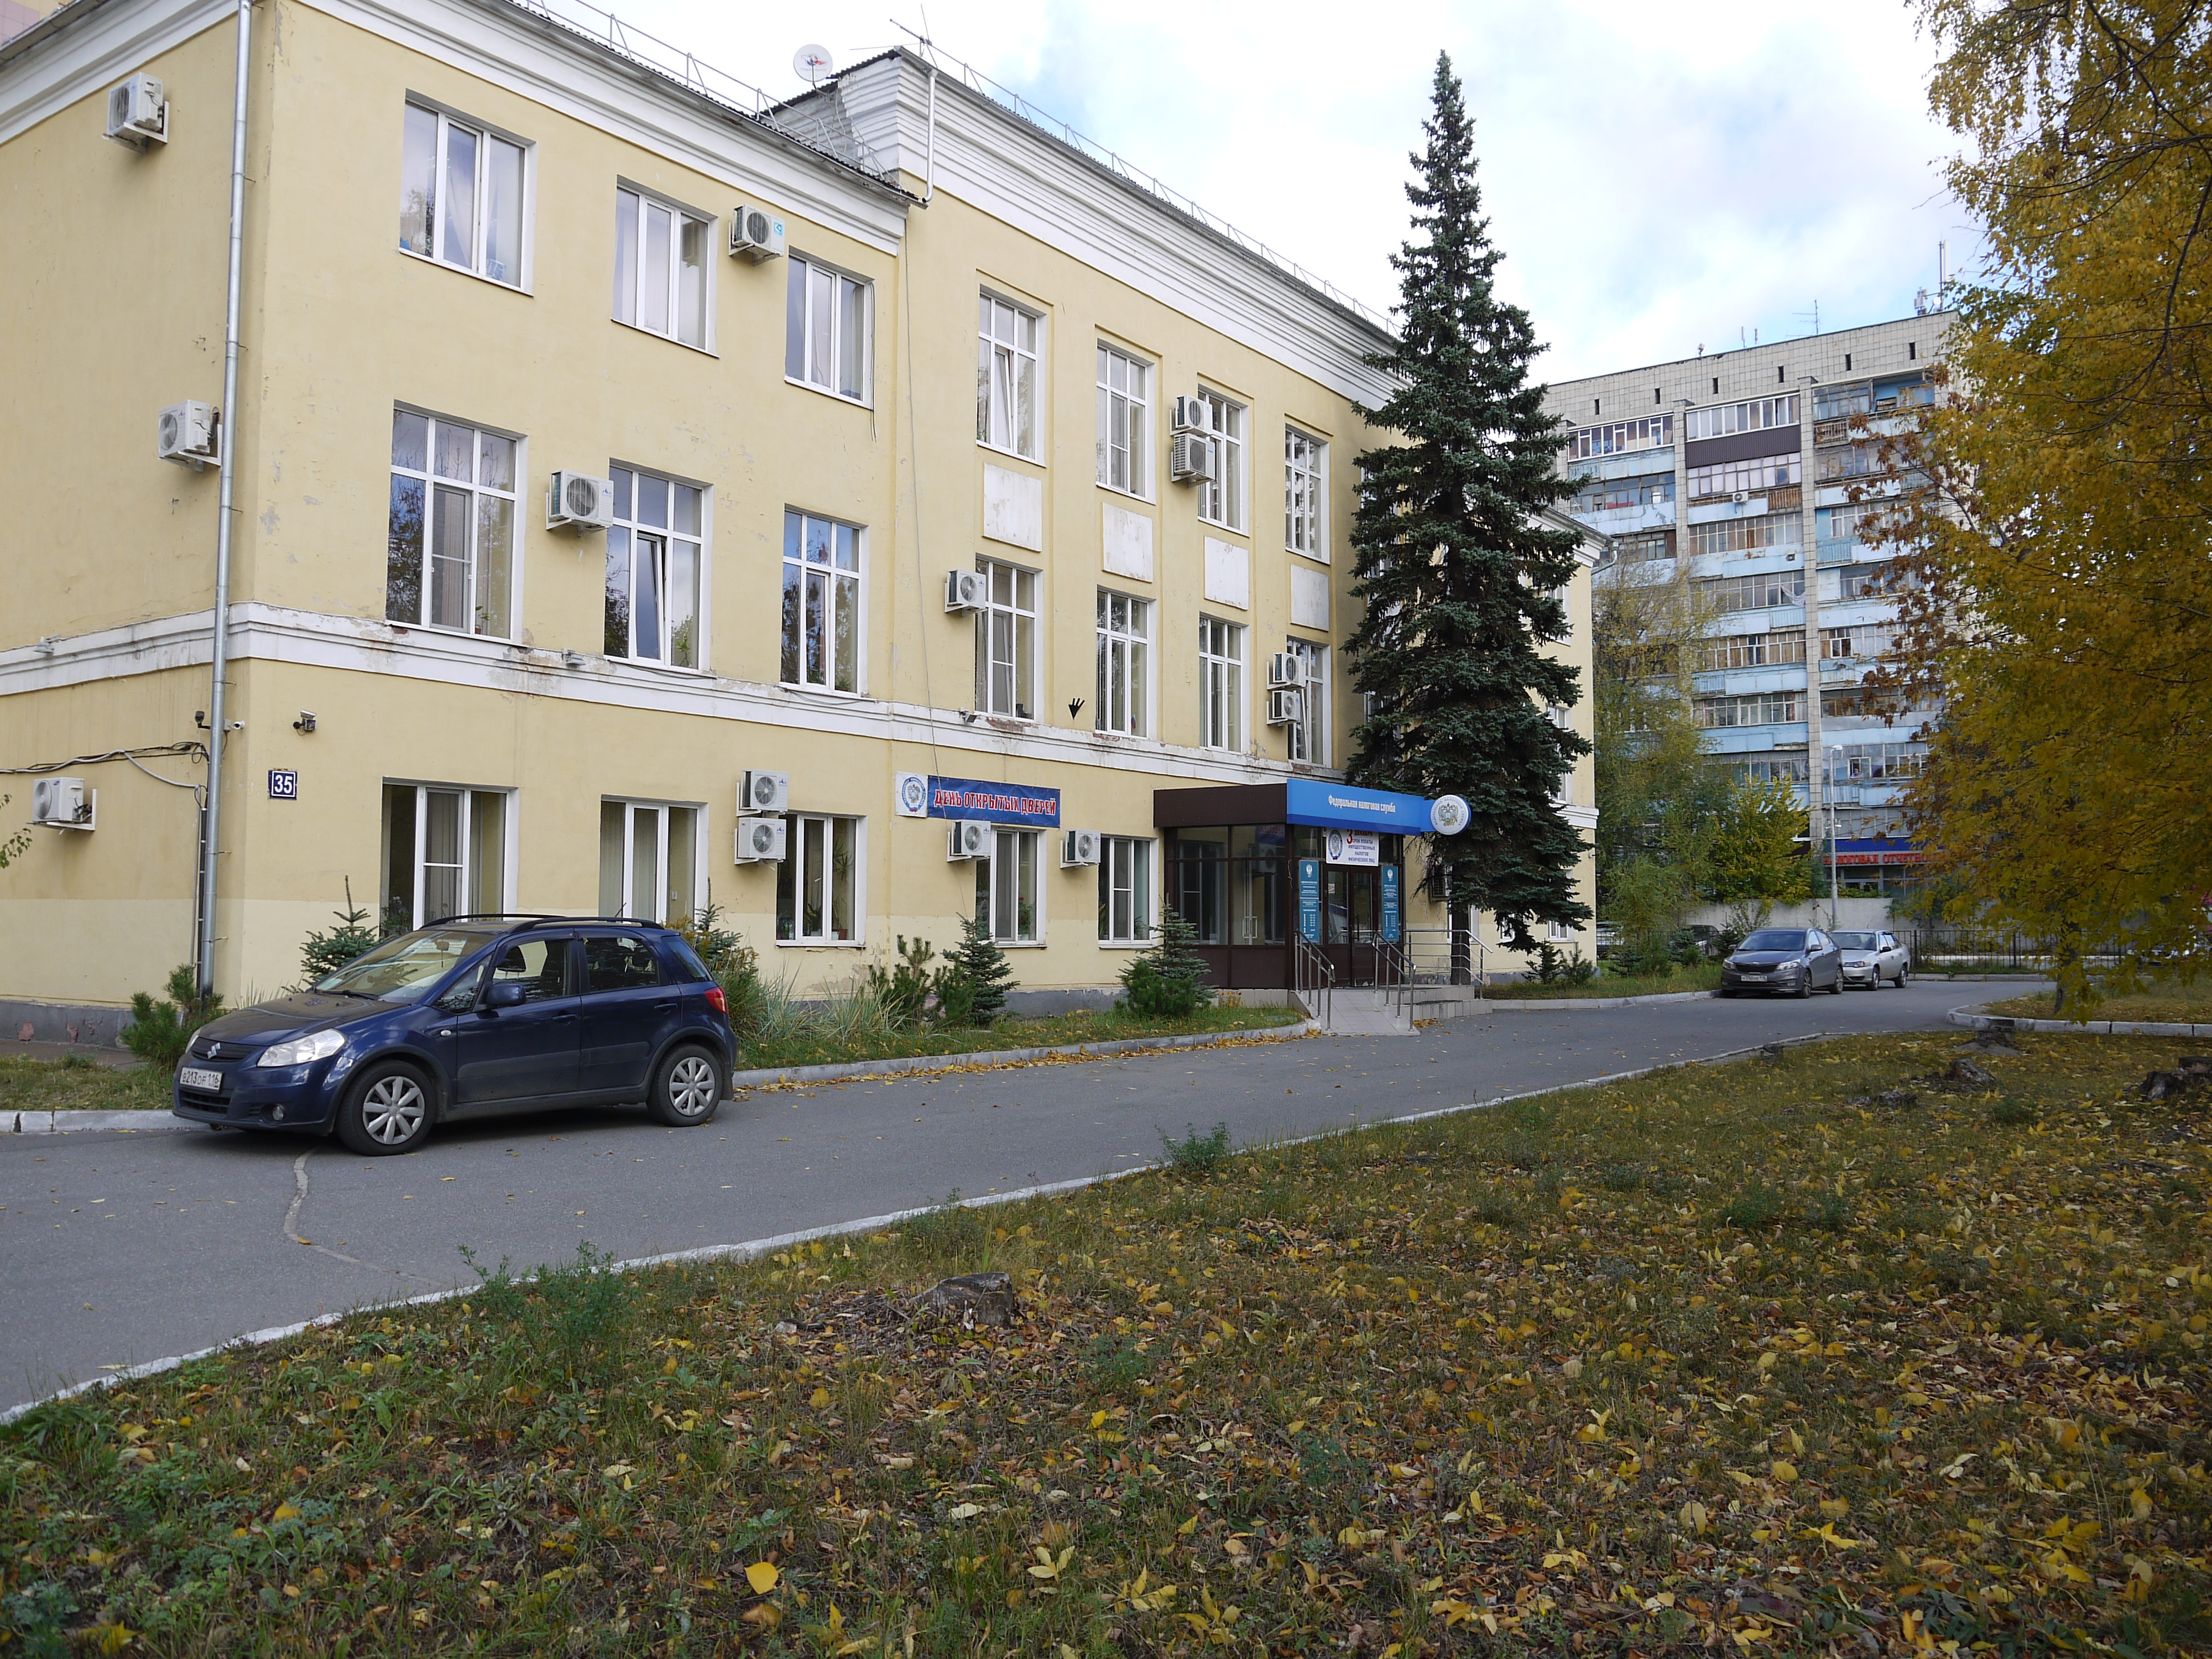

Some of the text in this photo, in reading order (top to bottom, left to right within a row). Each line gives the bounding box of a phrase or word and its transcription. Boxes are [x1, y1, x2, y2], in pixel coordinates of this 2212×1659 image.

[274, 774, 293, 794] 35
[934, 789, 962, 807] ДЕНЬ
[964, 792, 1020, 812] ОТКРЫТЫХ
[1021, 797, 1056, 815] ДВЕРЕЙ
[1328, 795, 1395, 814] Федеральная налоговая служба
[1347, 830, 1353, 844] 3
